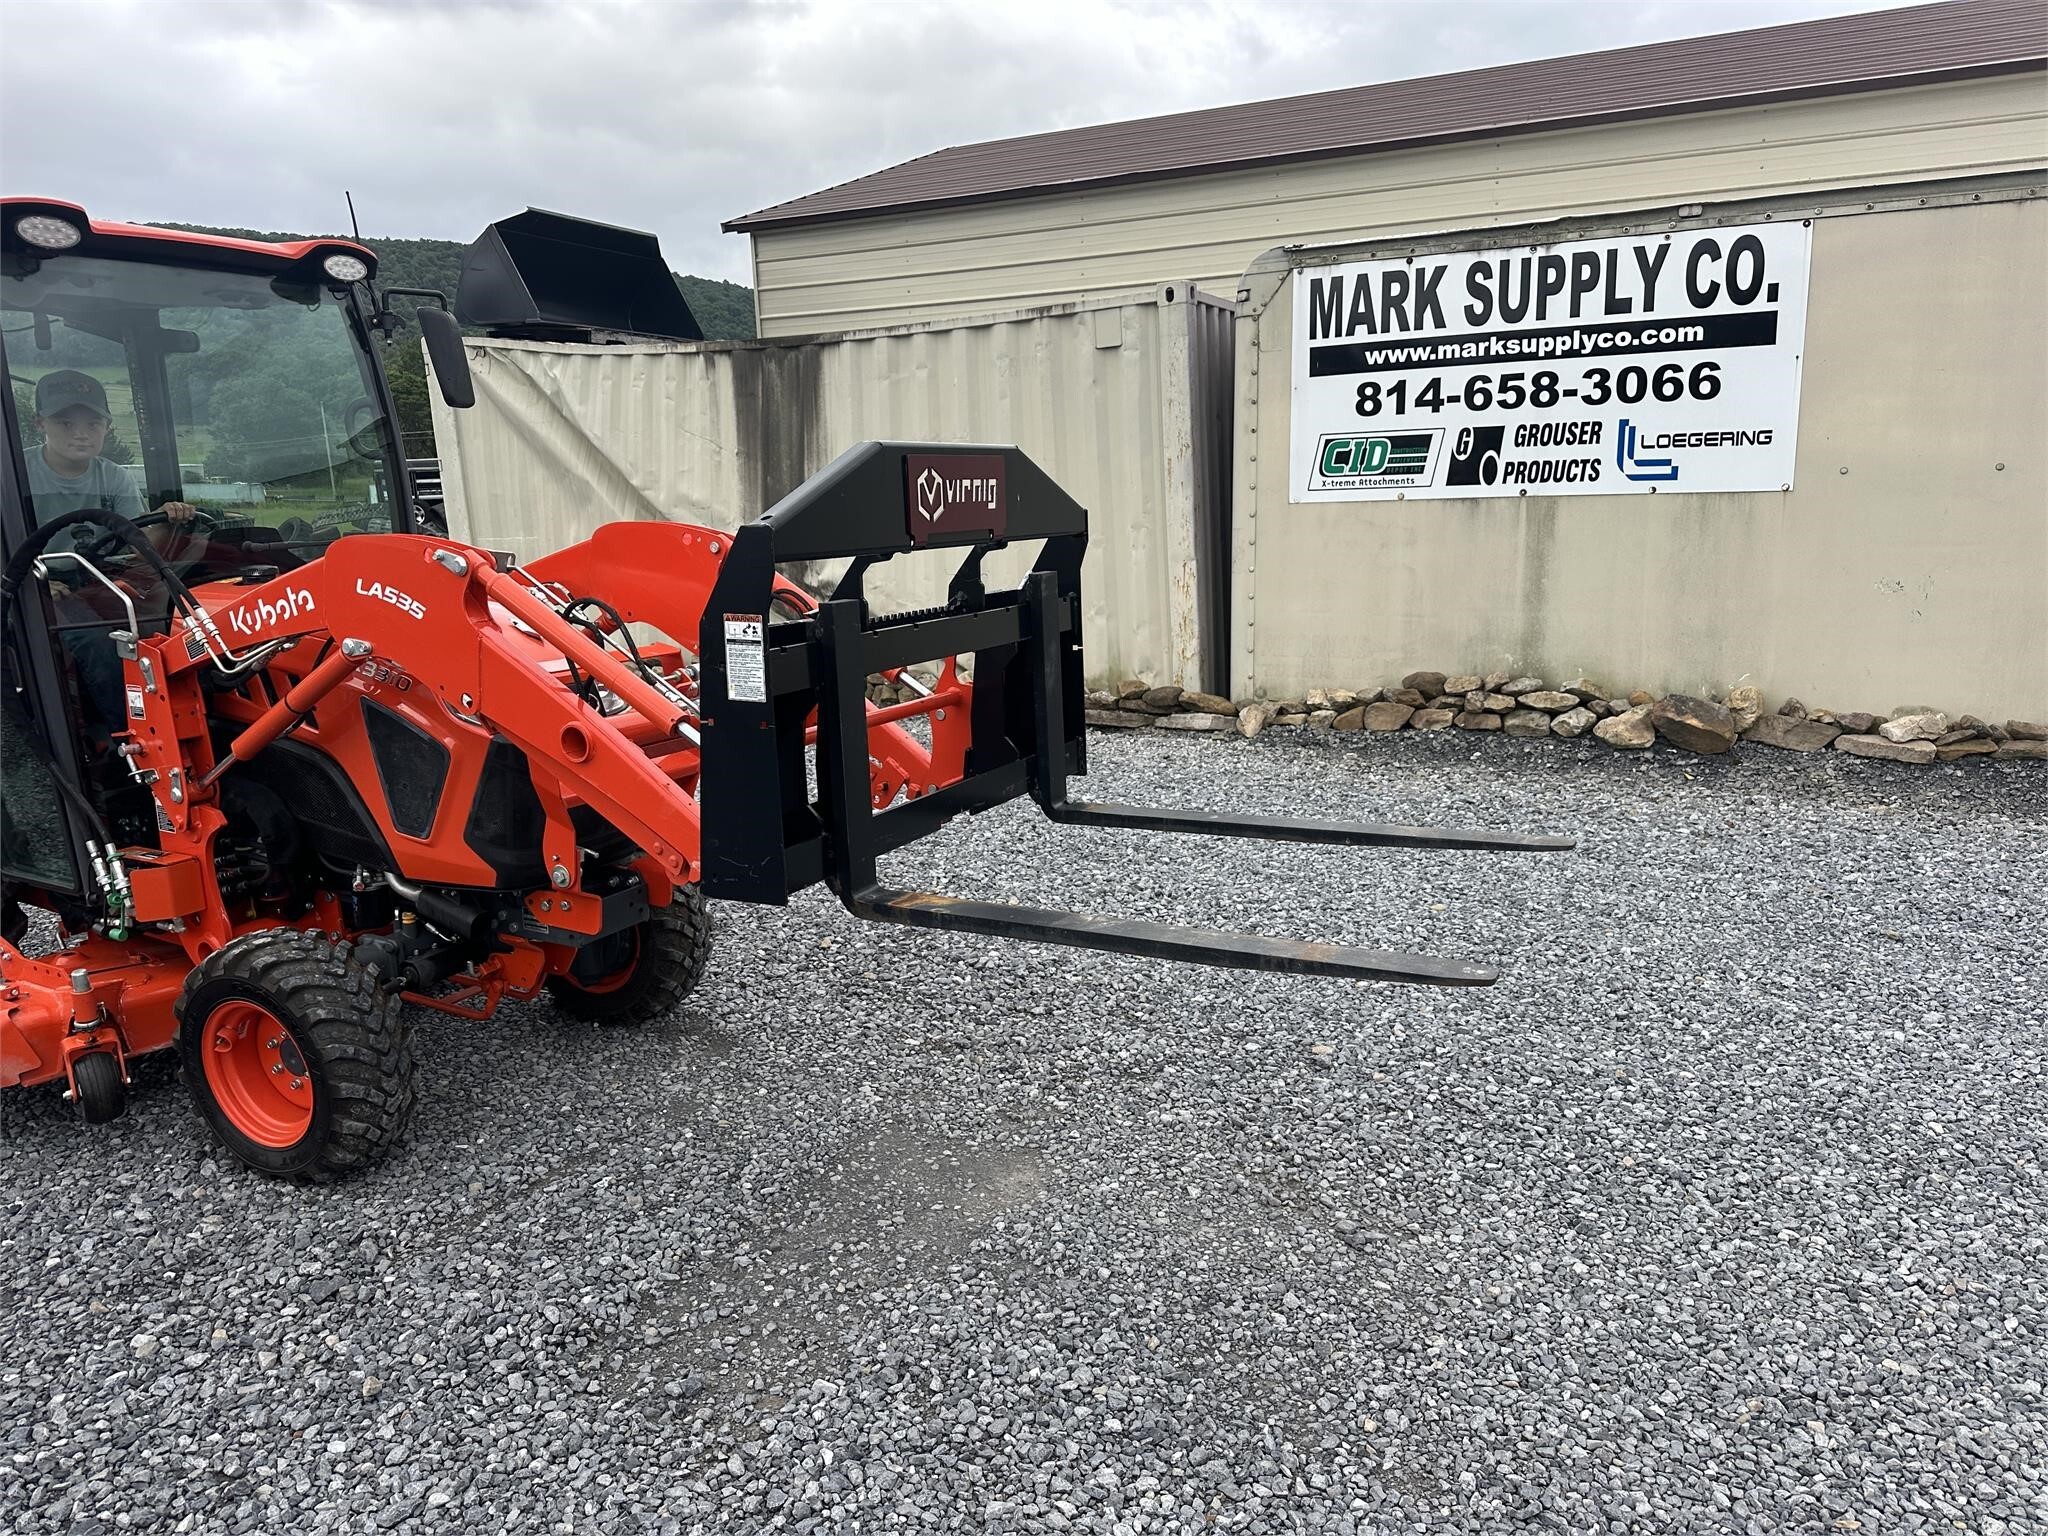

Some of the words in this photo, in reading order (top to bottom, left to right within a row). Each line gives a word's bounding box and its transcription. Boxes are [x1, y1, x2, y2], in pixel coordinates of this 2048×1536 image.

[1309, 265, 1448, 340] MARK
[1464, 243, 1671, 327] SUPPLY
[1685, 234, 1779, 309] CO.
[1365, 325, 1704, 365] www.marksupplyco.com
[1355, 361, 1722, 417] 814-658-3066
[1514, 421, 1602, 447] GROUSER
[1641, 430, 1773, 449] LOEGERING
[1322, 438, 1391, 476] CID
[1502, 458, 1601, 484] PRODUCTS
[1321, 478, 1356, 487] X-treme
[1359, 477, 1415, 487] Attachments
[228, 586, 316, 636] Kubota
[356, 578, 427, 620] LA535
[730, 614, 760, 622] WARNING
